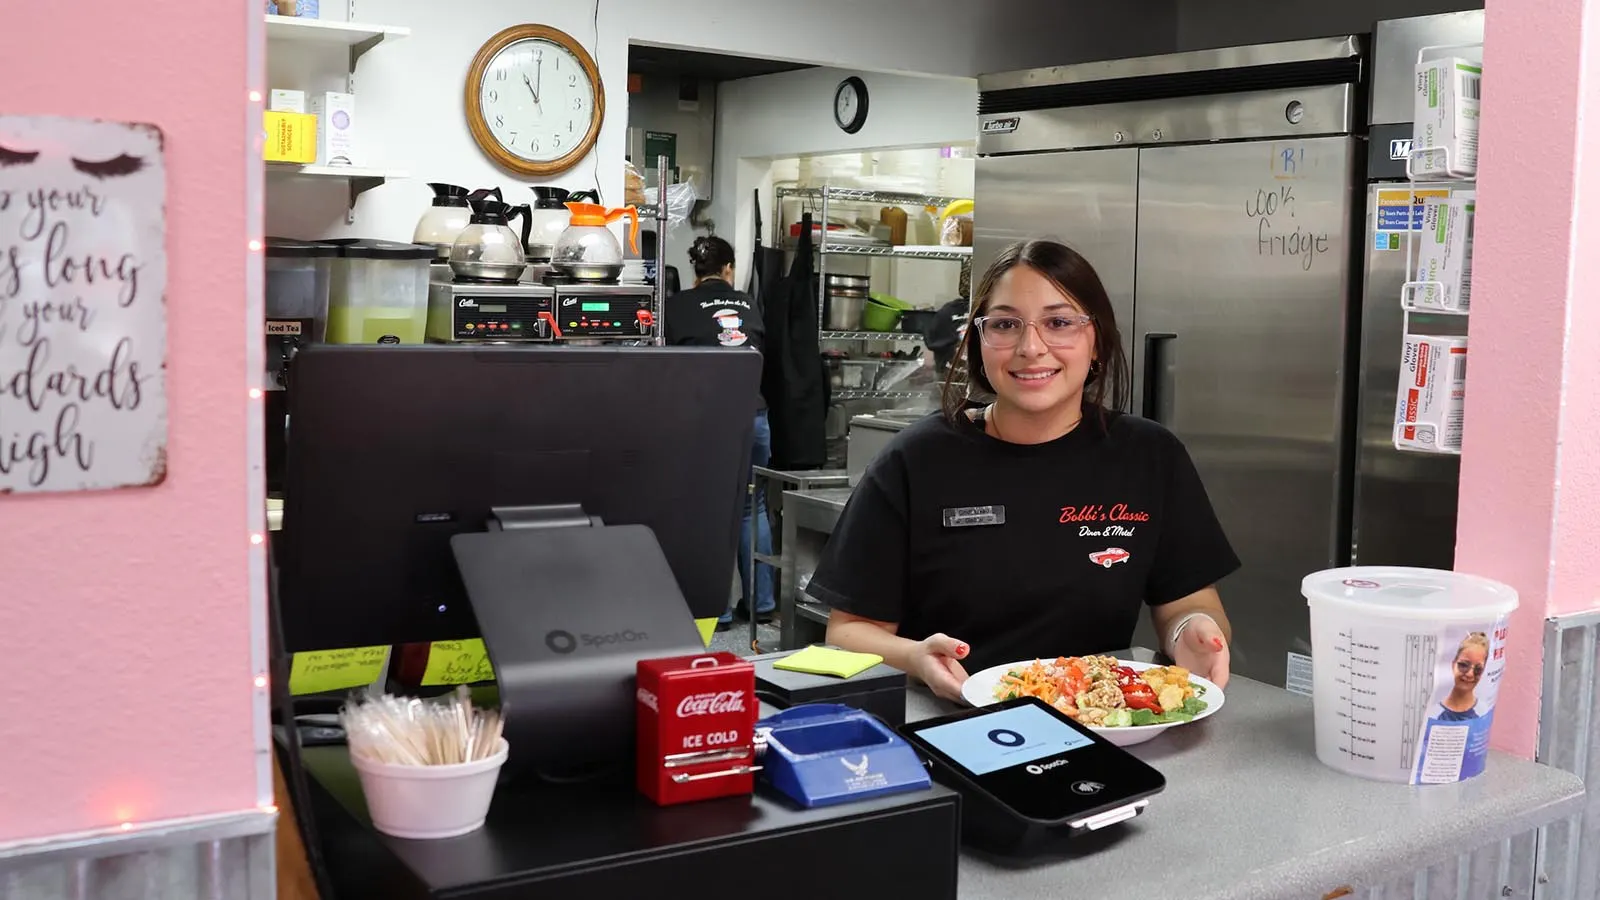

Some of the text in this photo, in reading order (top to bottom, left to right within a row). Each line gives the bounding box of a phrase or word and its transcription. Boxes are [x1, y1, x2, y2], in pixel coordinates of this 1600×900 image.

[496, 69, 507, 81] 10
[568, 75, 577, 88] 2
[489, 90, 498, 103] 9
[573, 97, 581, 110] 3
[495, 115, 504, 128] 8
[566, 120, 573, 132] 4
[510, 132, 518, 145] 7
[531, 138, 539, 153] 6
[553, 134, 561, 148] 5
[1392, 141, 1412, 157] M
[20, 184, 105, 241] your
[1259, 217, 1328, 271] fridge
[44, 220, 147, 308] long
[16, 296, 97, 347] your
[268, 324, 299, 332] Iced Tea
[1404, 342, 1412, 365] Vinyl
[1410, 343, 1418, 373] Gloves
[0, 337, 153, 412] dards
[1406, 398, 1417, 432] Cassic
[1059, 503, 1149, 523] Bobbi's Classic
[1079, 525, 1135, 537] Diner & Motel
[581, 630, 649, 649] SpotOn
[683, 730, 738, 748] ICE COLD
